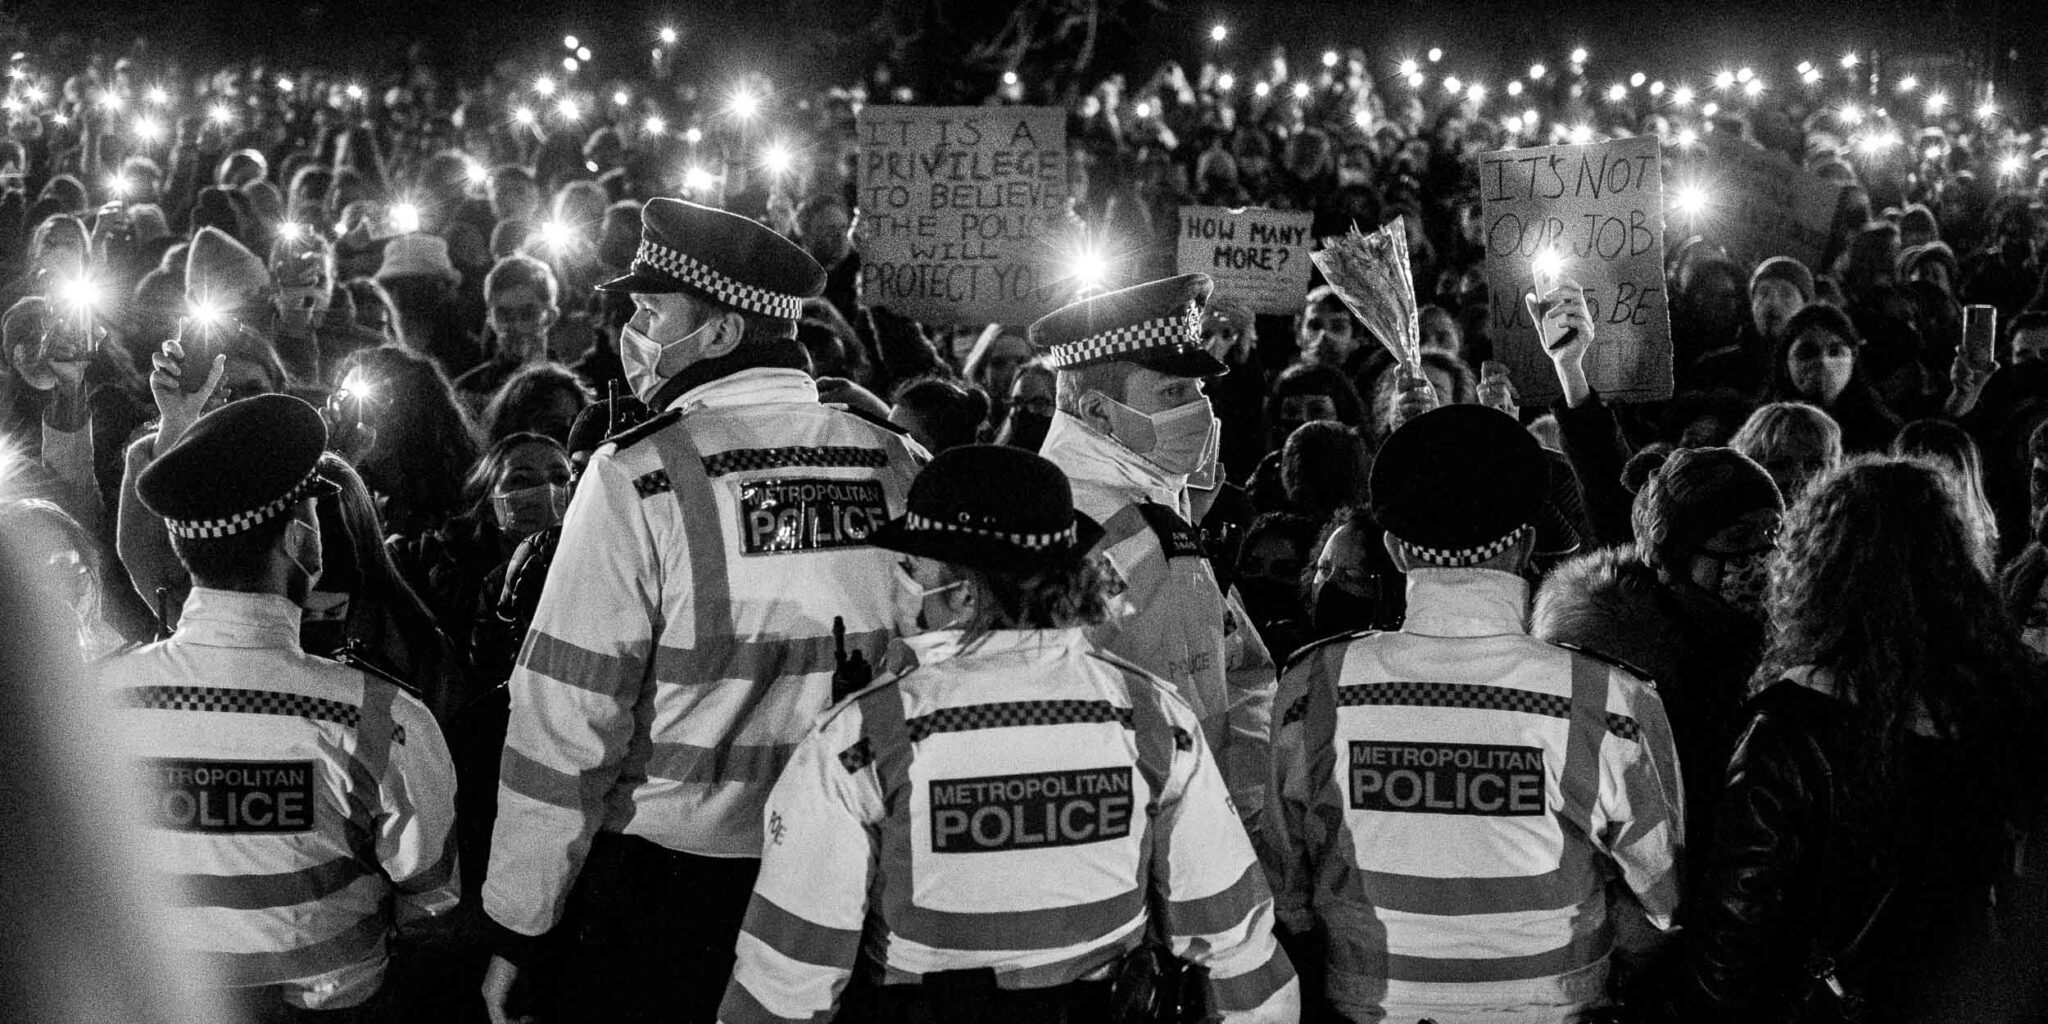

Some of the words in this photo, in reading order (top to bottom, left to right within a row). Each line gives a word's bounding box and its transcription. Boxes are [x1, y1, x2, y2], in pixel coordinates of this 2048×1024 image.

[865, 120, 914, 146] IT
[937, 119, 981, 146] IS
[1008, 120, 1036, 147] A
[866, 150, 1061, 181] PRIVILEGE
[1576, 153, 1657, 200] NOT
[866, 184, 909, 209] TO
[932, 182, 1063, 209] BELIEVE
[866, 214, 937, 238] THE
[1188, 216, 1235, 240] HOW
[1251, 222, 1306, 246] MANY
[1572, 209, 1655, 260] JOB
[912, 243, 998, 260] WILL
[1213, 245, 1290, 273] MORE?
[863, 262, 982, 302] PROTECT
[1606, 281, 1661, 326] BE
[749, 484, 880, 506] METROPOLITAN
[1352, 745, 1543, 770] METROPOLITAN
[167, 768, 305, 788] TROPOLITAN
[933, 772, 1130, 806] METROPOLITAN
[1352, 767, 1542, 812] POLICE
[163, 788, 306, 827] OLICE
[934, 795, 1130, 848] POLICE
